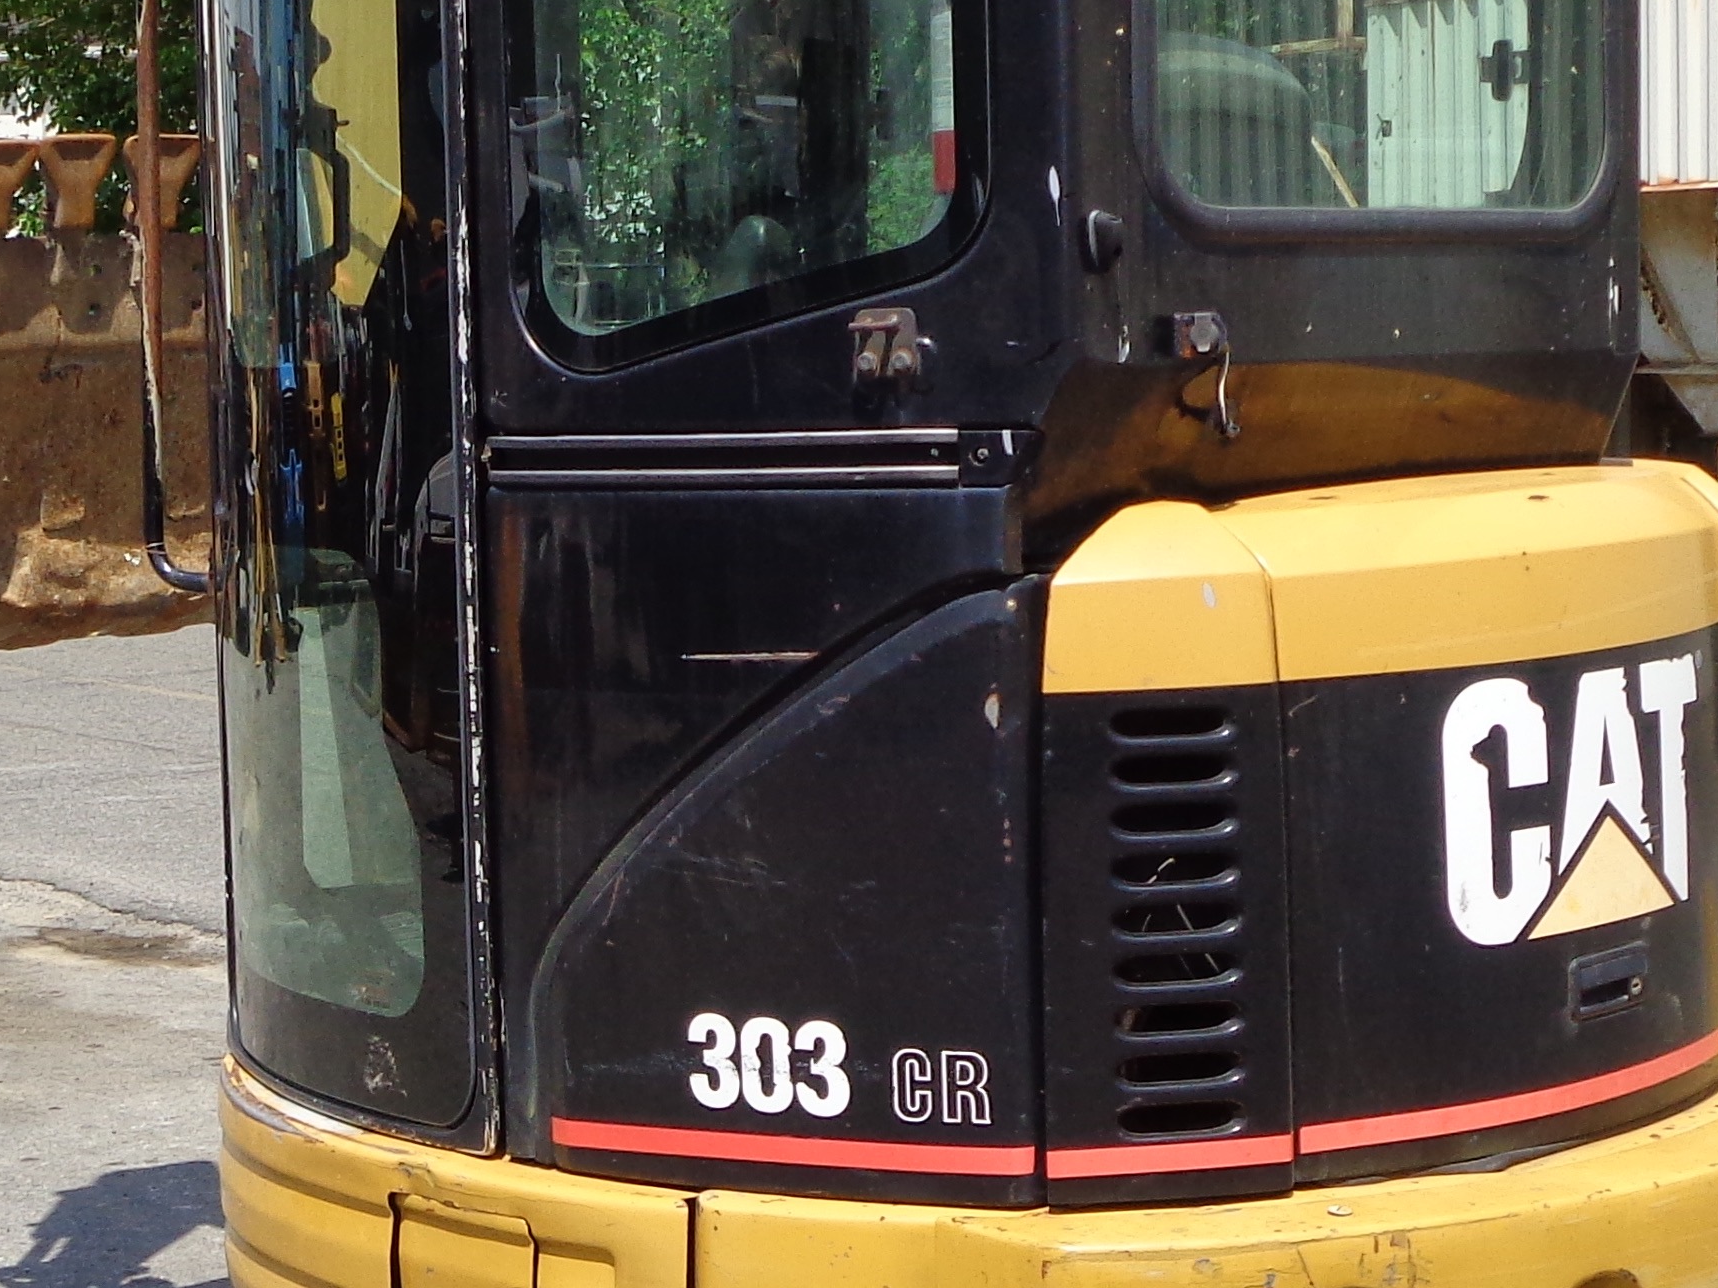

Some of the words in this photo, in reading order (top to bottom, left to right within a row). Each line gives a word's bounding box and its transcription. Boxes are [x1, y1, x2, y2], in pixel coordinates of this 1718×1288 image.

[1442, 653, 1697, 946] CAT
[688, 1013, 851, 1118] 303
[892, 1048, 992, 1124] CR
